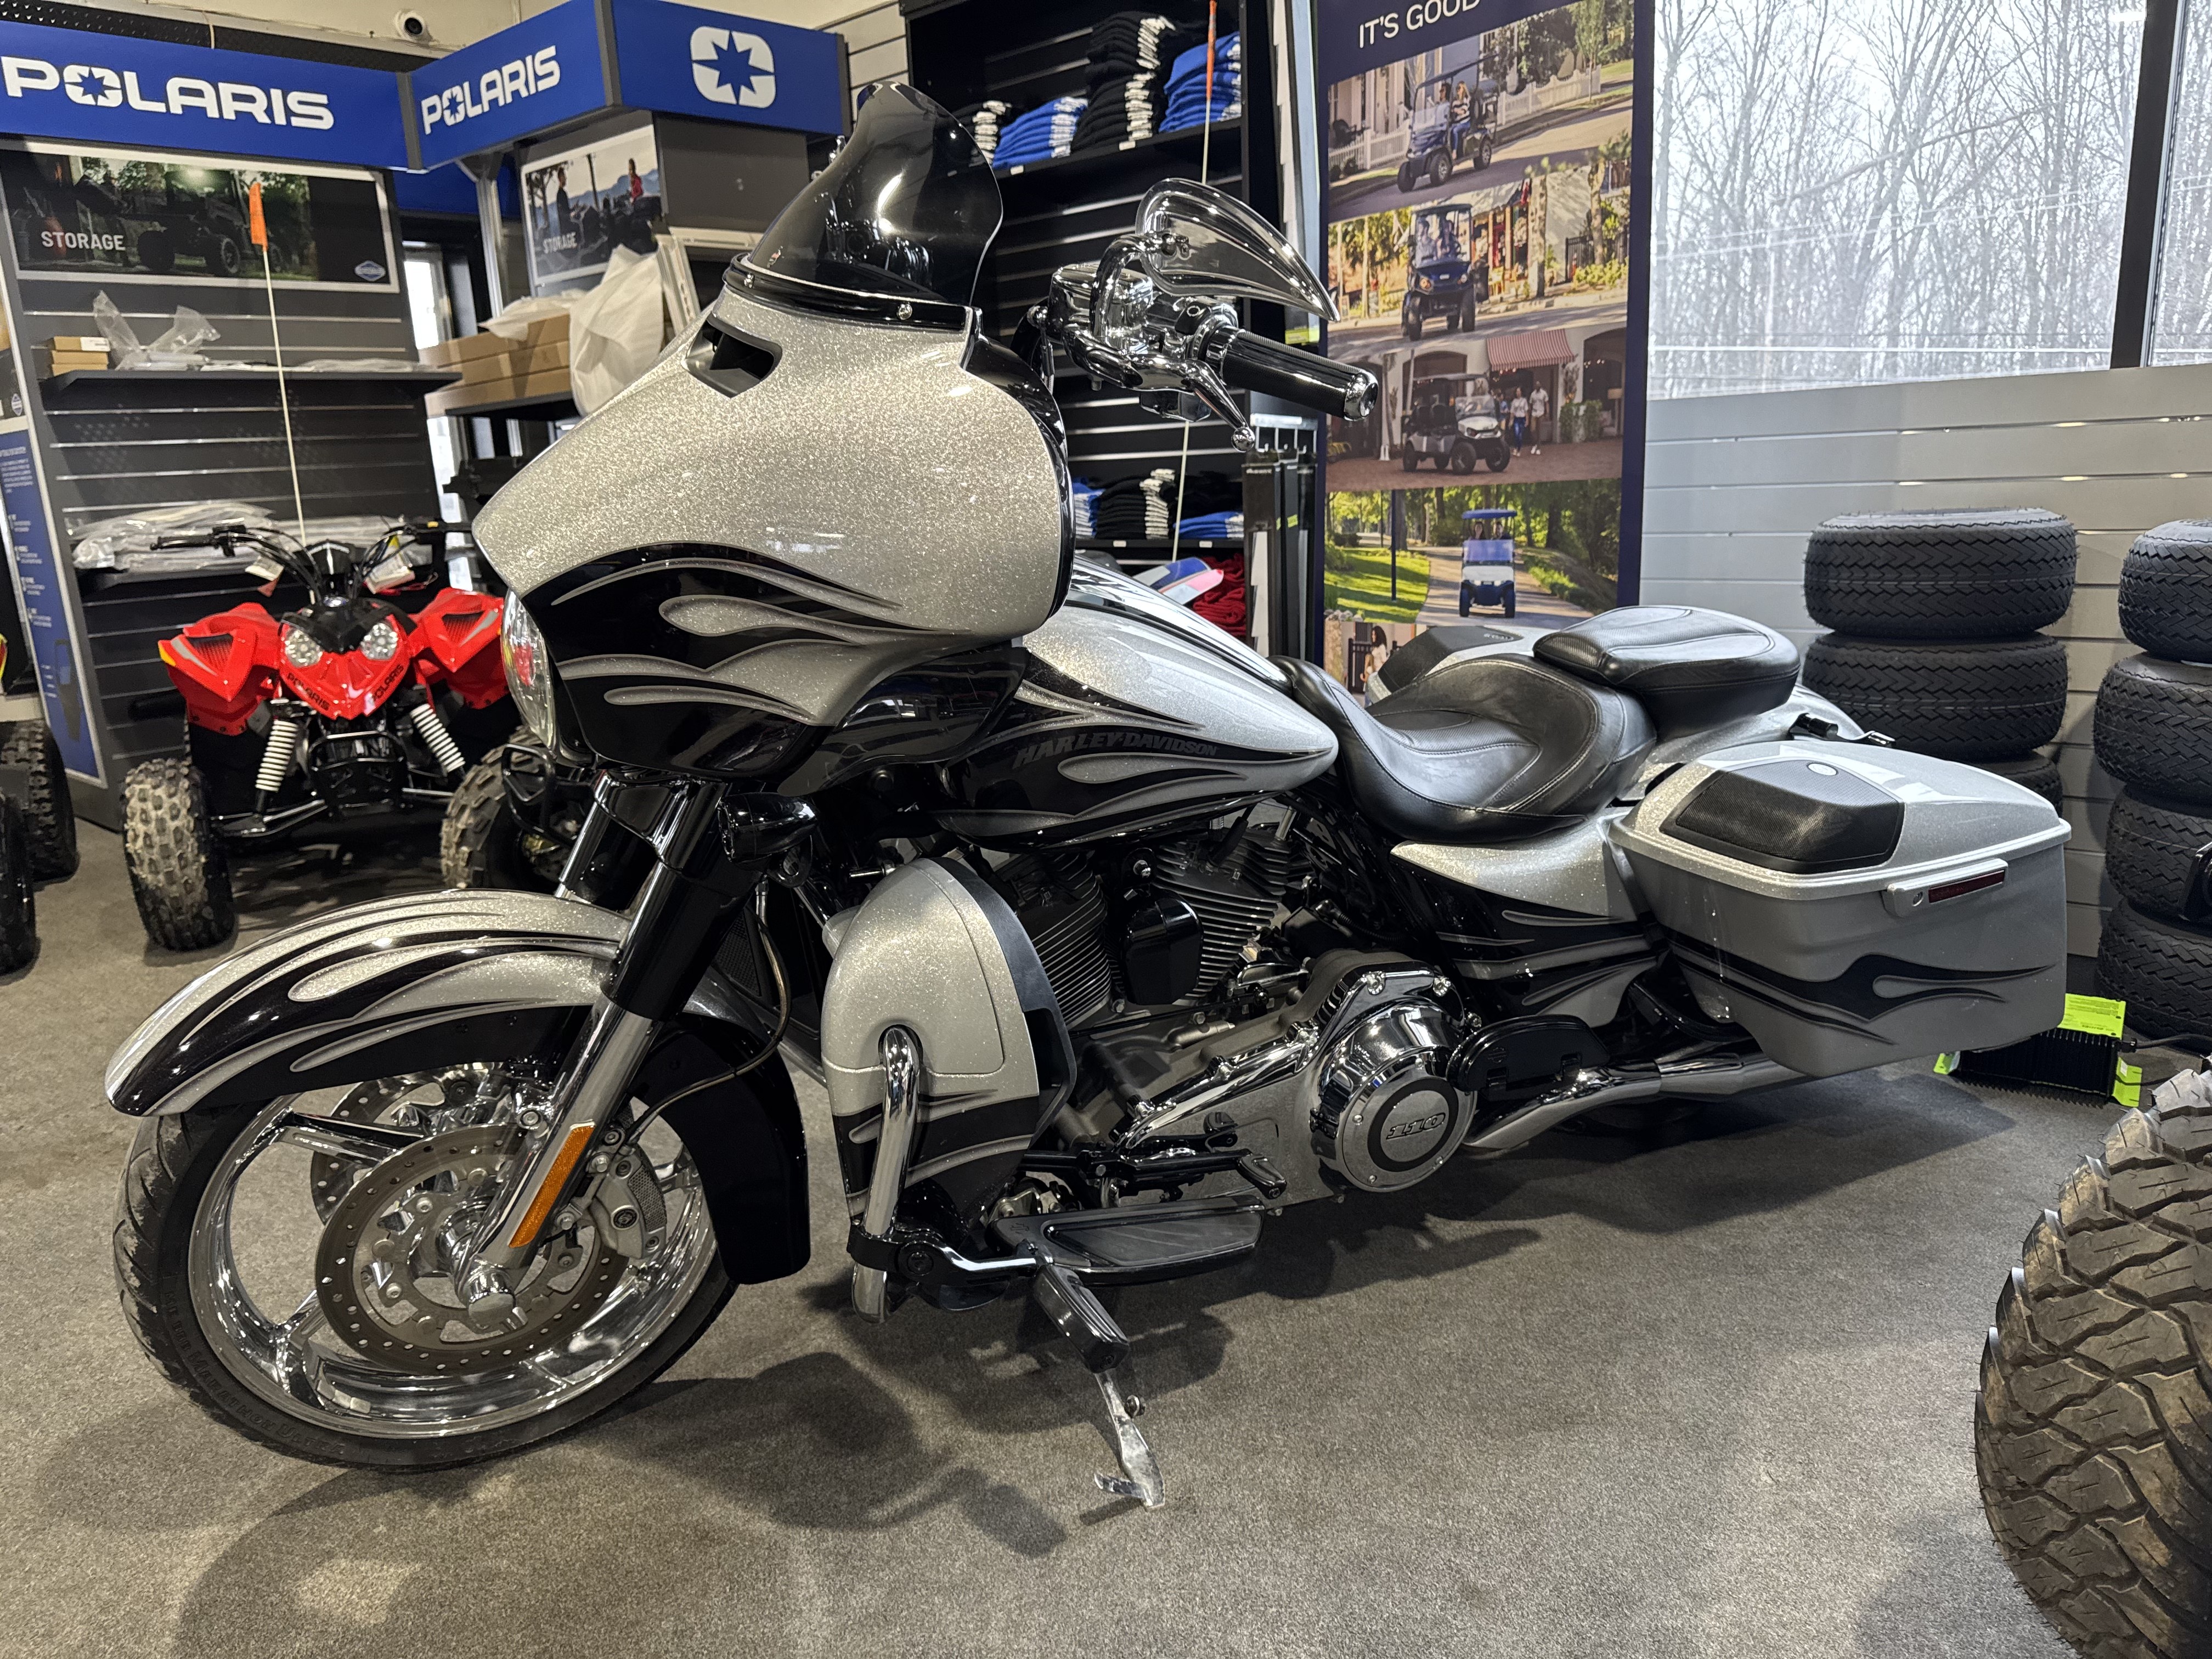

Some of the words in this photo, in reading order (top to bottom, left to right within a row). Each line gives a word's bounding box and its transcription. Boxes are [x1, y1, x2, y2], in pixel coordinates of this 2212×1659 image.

[1359, 12, 1399, 48] IT'S
[1, 57, 334, 129] POLARIS
[421, 45, 561, 135] POLARIS
[41, 230, 126, 251] STORAGE
[543, 232, 577, 253] STORAGE
[287, 673, 330, 711] POARIS
[1386, 1111, 1446, 1141] 110
